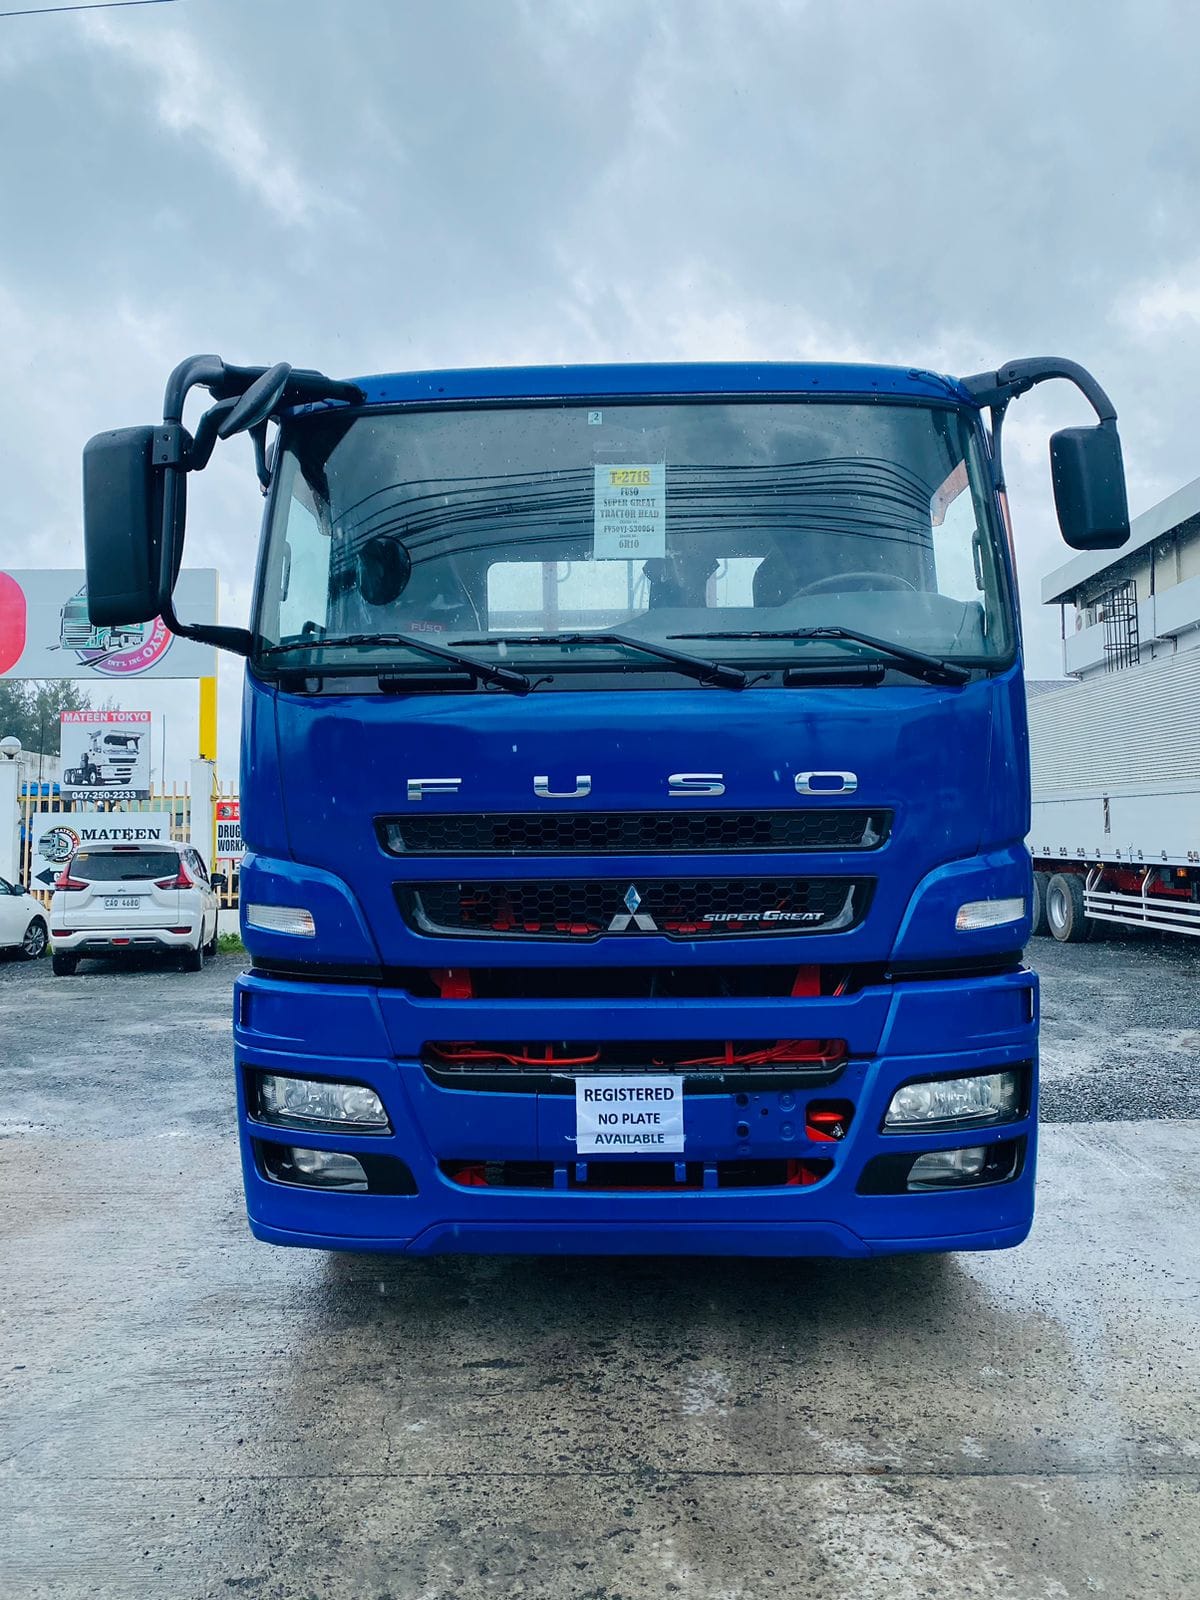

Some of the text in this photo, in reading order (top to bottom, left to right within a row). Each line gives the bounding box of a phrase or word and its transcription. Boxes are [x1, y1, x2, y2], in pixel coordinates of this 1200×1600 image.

[609, 470, 650, 484] T-2718
[620, 487, 639, 496] FUSO
[603, 498, 656, 507] SUPER GREAT
[600, 510, 660, 519] TRACTOR HEAD
[142, 616, 167, 658] OKYO
[64, 712, 148, 722] MATEEN TOKYO
[407, 771, 858, 801] FUSO
[72, 791, 136, 800] 047-250-2233
[81, 828, 161, 841] MATEEN
[217, 824, 241, 838] DRUG
[702, 913, 761, 922] SUPER
[584, 1087, 675, 1102] REGISTERED
[598, 1112, 661, 1125] NO PLATE
[595, 1133, 665, 1145] AVAILABLE
